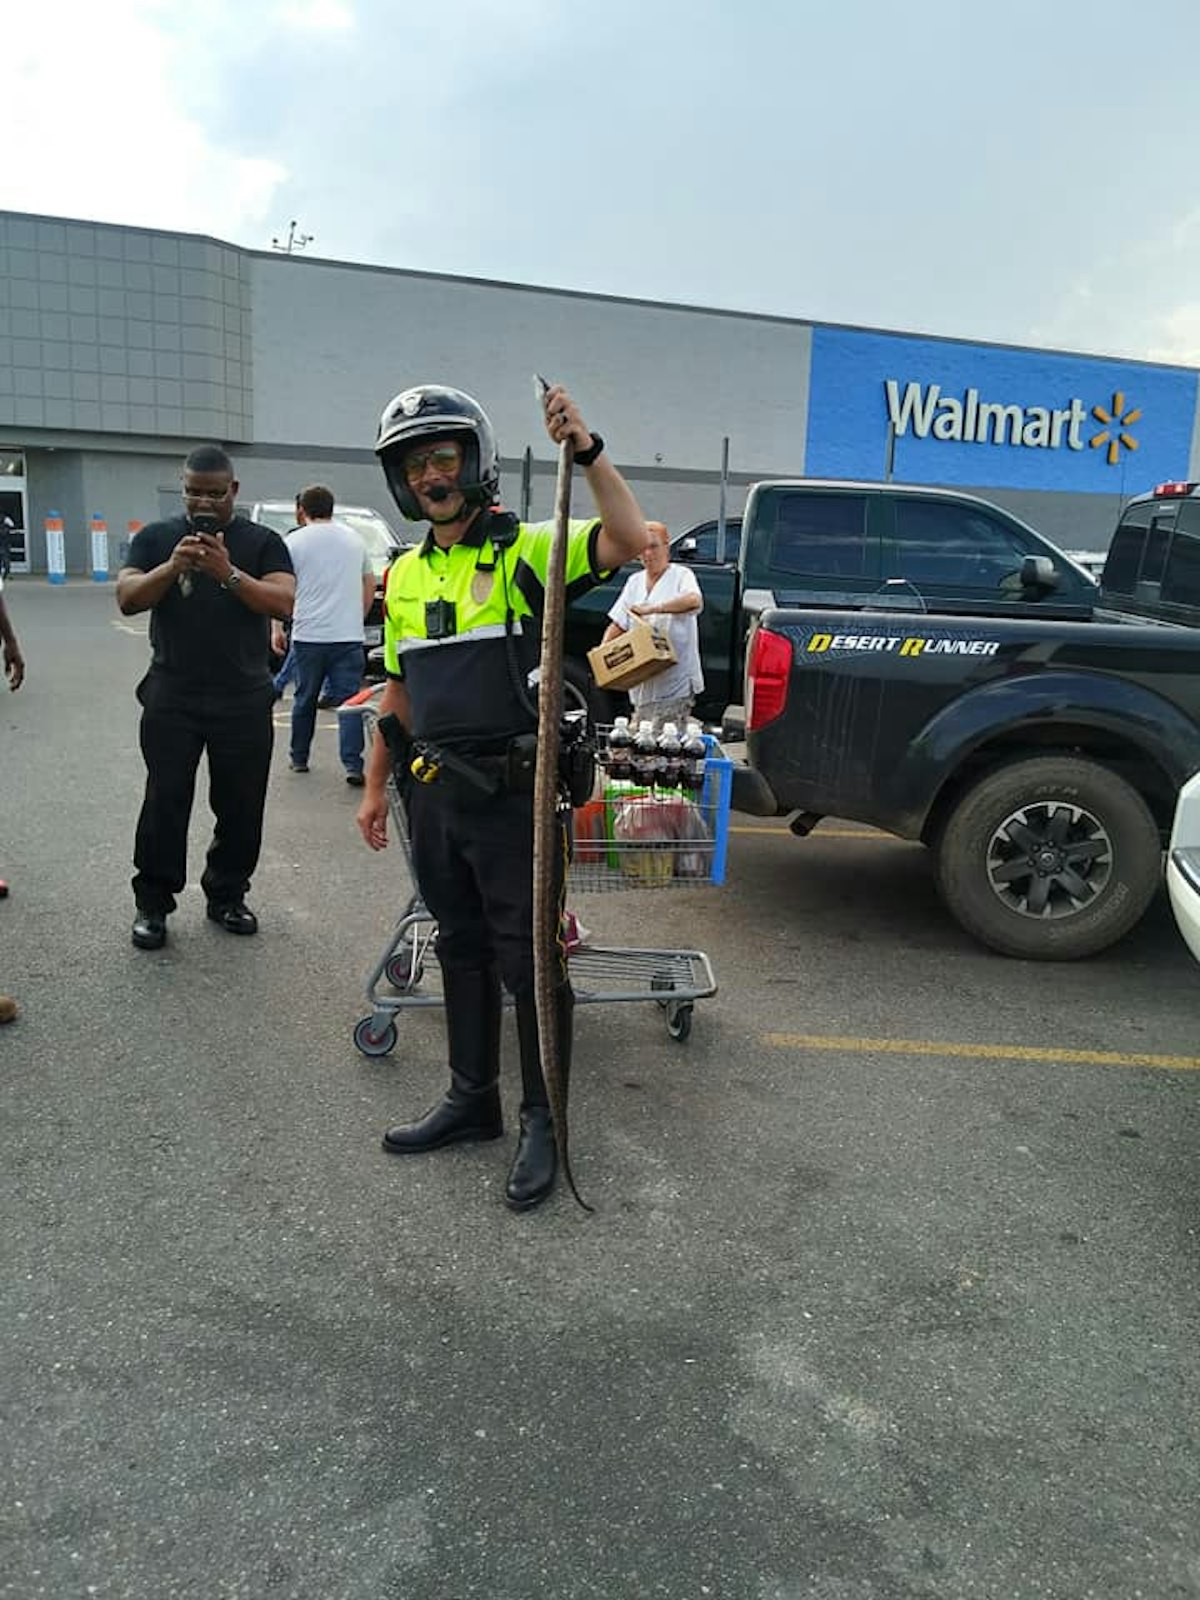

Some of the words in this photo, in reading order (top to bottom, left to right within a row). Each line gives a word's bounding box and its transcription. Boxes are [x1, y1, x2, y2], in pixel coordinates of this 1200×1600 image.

[885, 379, 1086, 450] Walmart
[807, 633, 900, 652] DESERT
[900, 637, 999, 656] RUNNER
